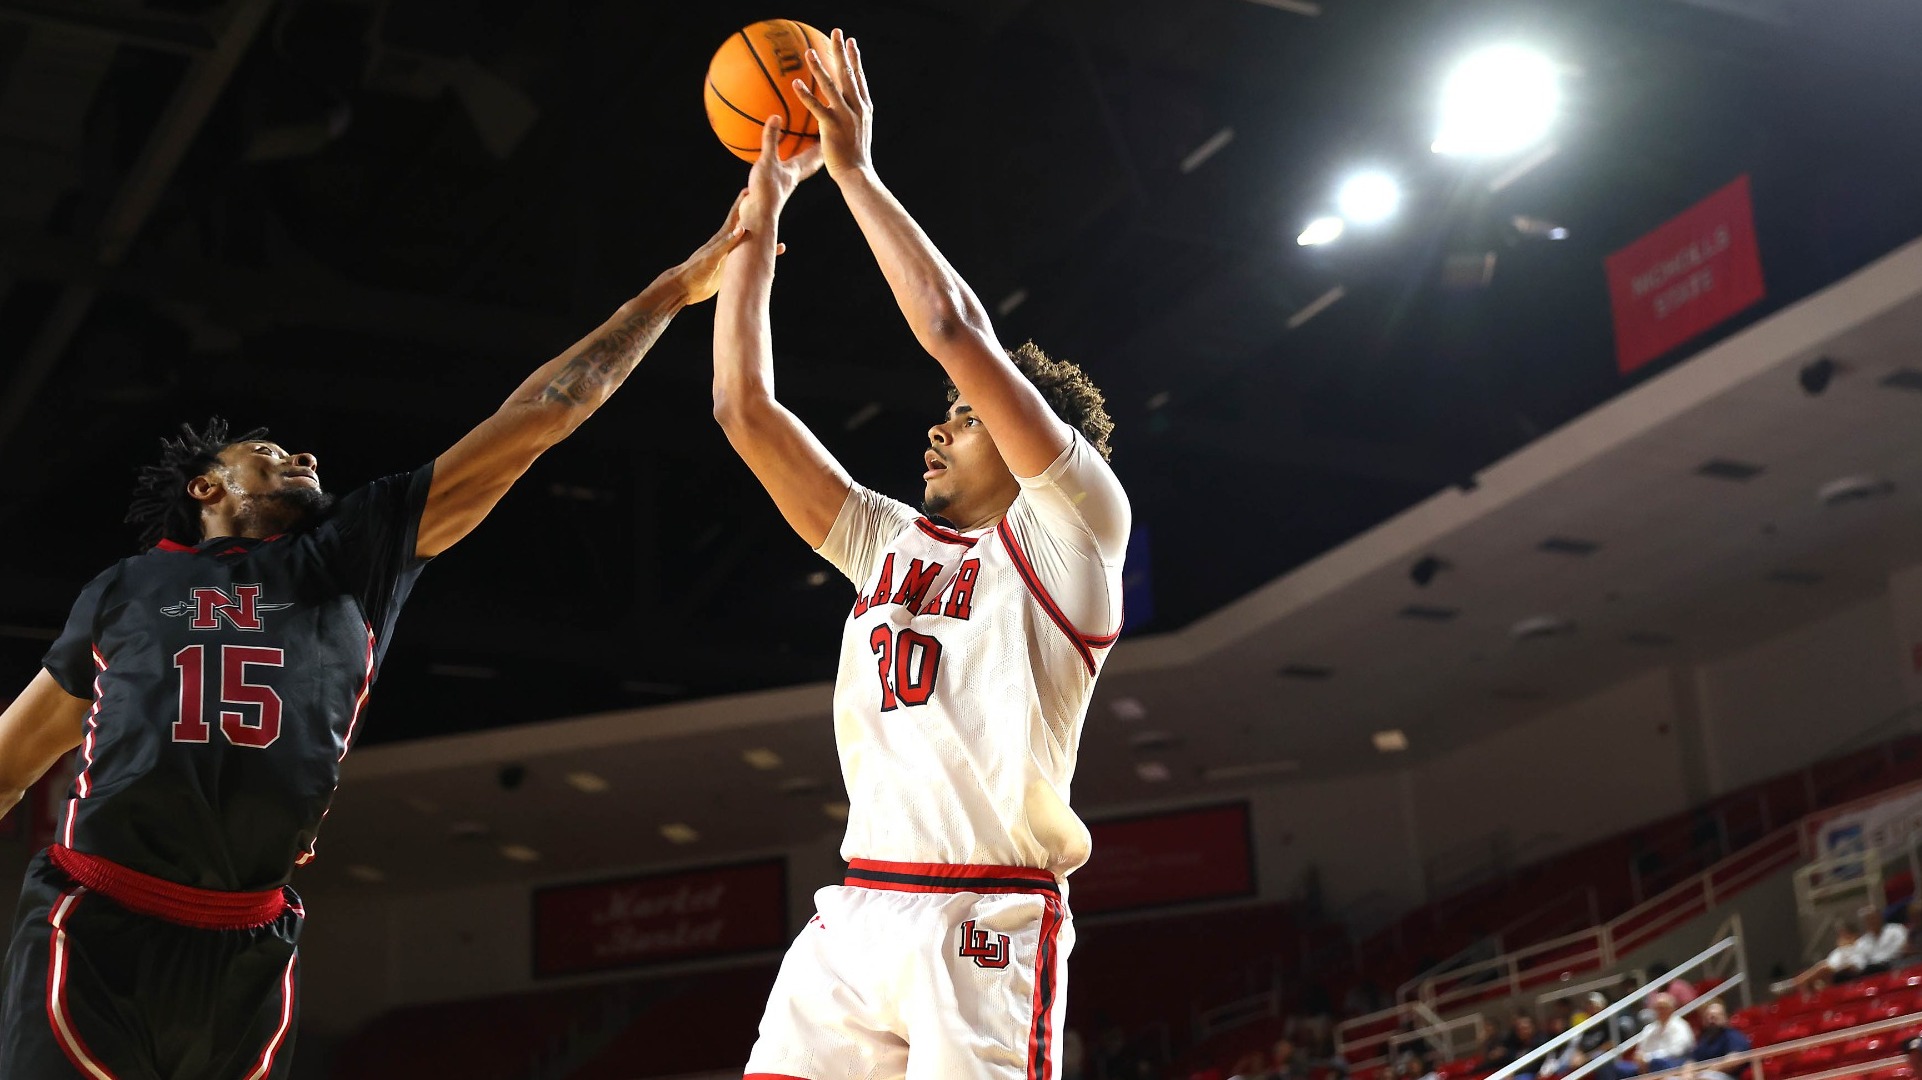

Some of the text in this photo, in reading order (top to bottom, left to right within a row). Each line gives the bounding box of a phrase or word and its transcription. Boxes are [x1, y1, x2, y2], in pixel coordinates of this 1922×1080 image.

[189, 583, 264, 632] N
[172, 644, 284, 749] 15
[870, 623, 942, 712] 20
[959, 919, 1010, 969] LU
